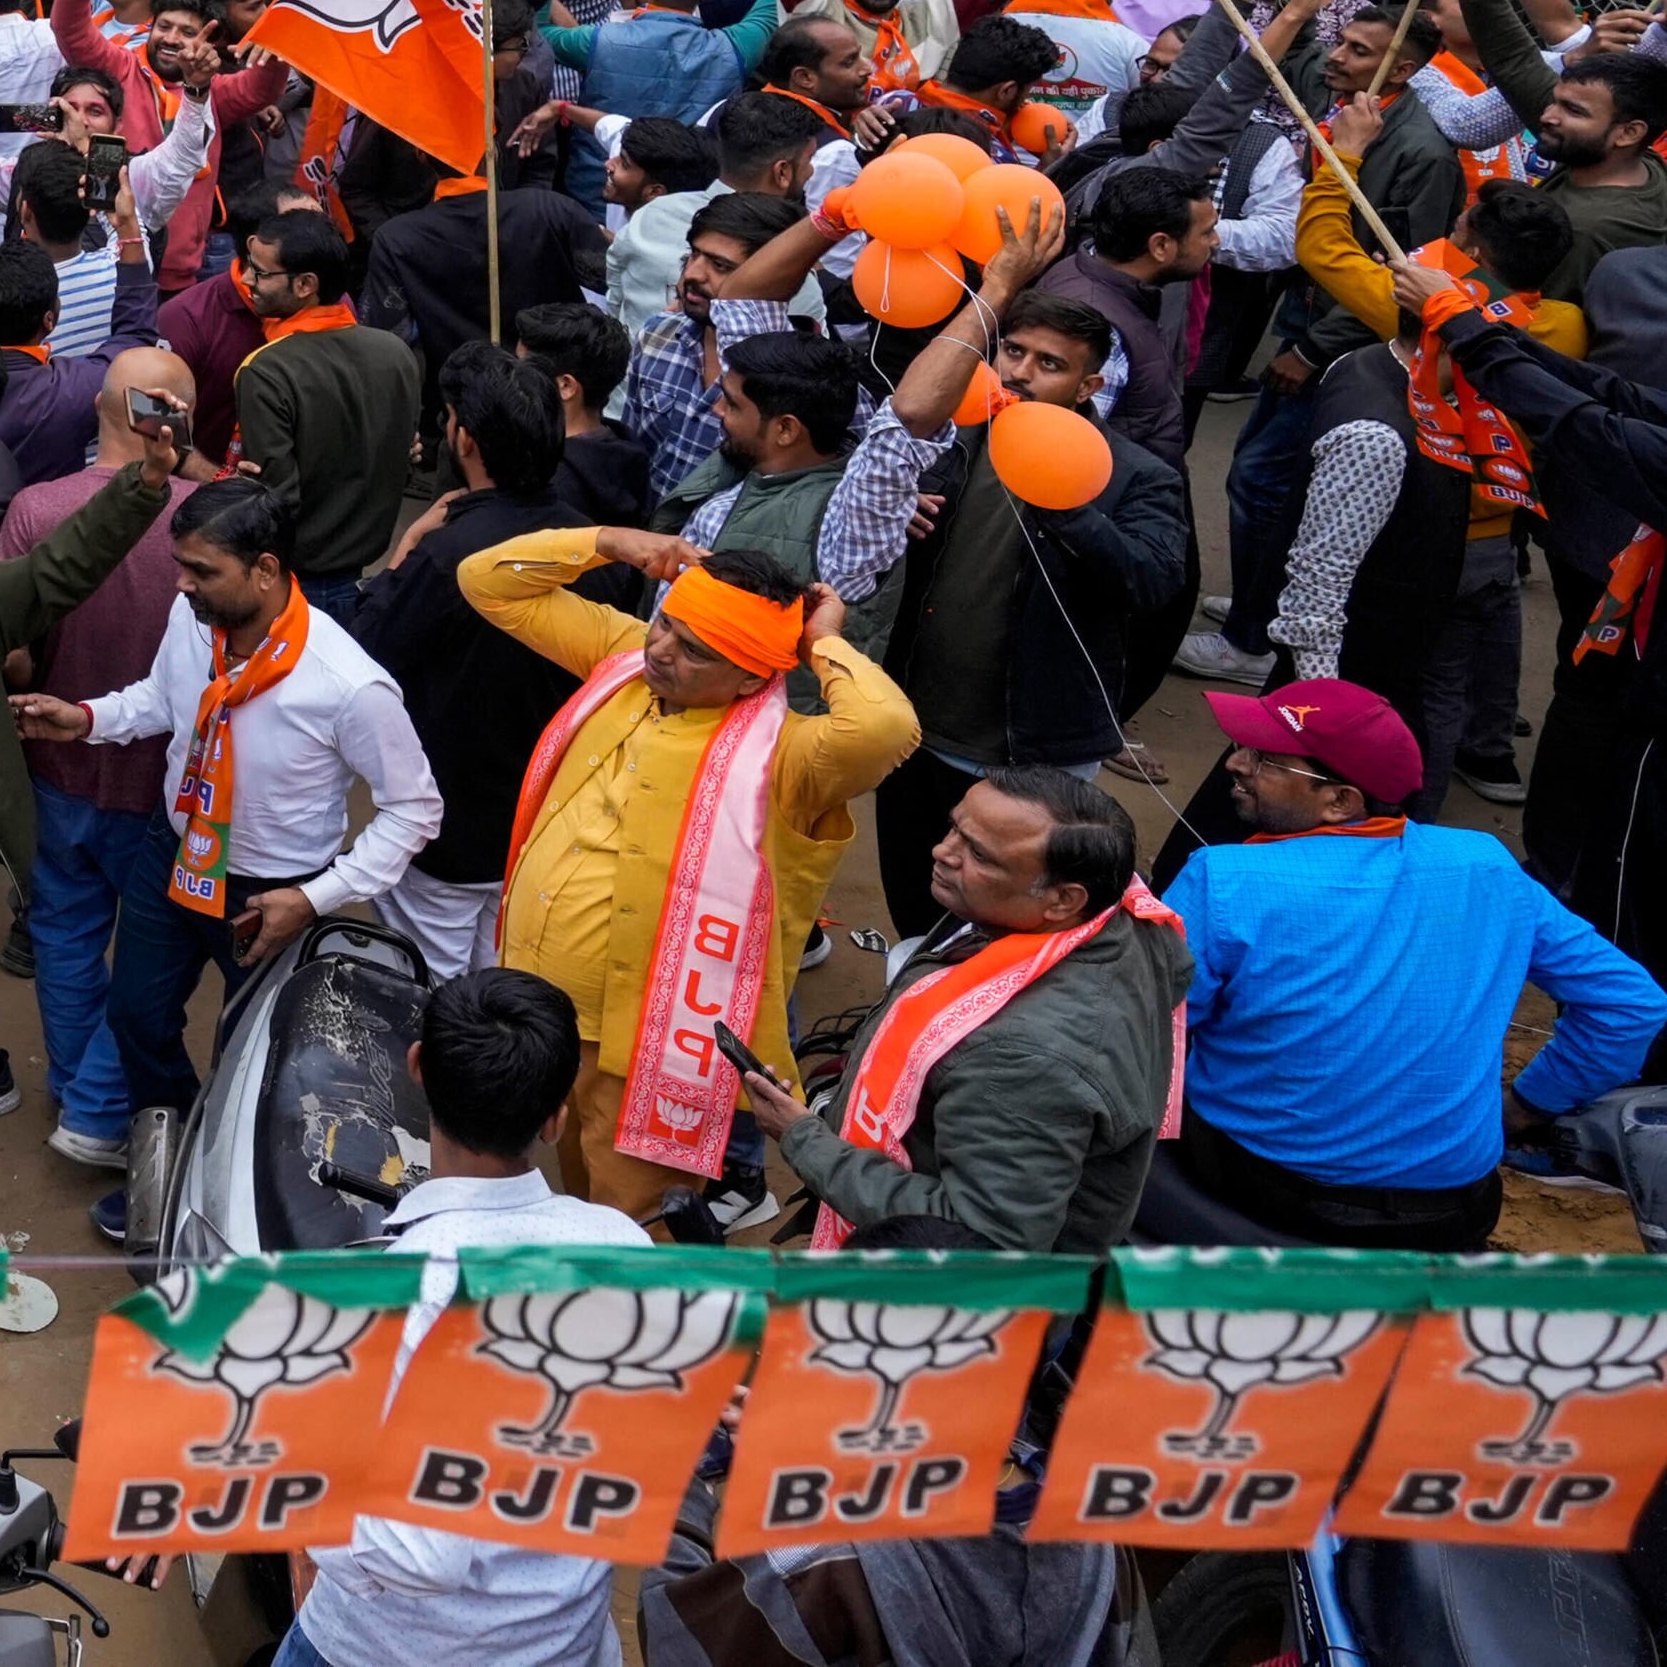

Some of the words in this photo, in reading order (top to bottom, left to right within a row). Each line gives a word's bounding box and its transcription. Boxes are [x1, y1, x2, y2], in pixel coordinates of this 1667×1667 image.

[1277, 705, 1304, 732] JORDAN
[112, 1474, 329, 1539] BJP
[410, 1449, 641, 1532] BJP
[765, 1455, 967, 1528] BJP
[1081, 1465, 1298, 1522] BJP
[1381, 1470, 1613, 1526] BJP
